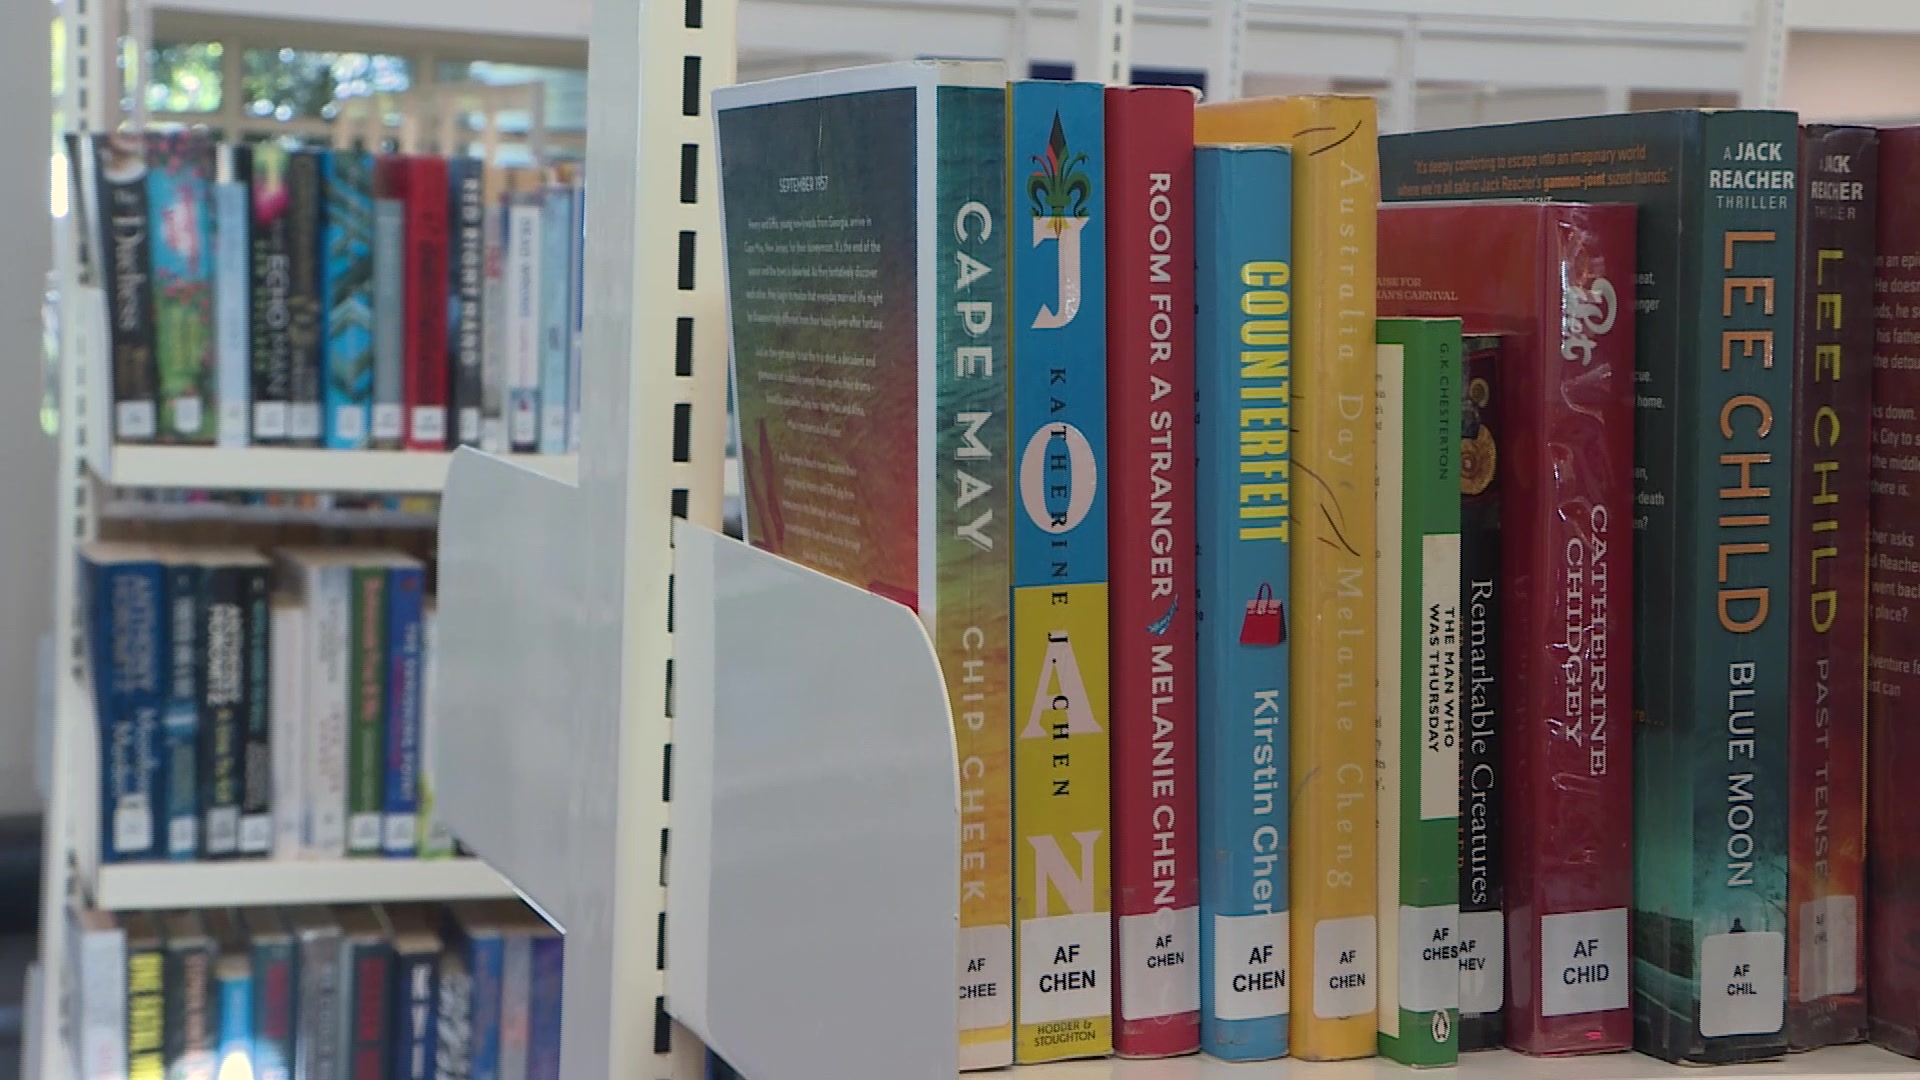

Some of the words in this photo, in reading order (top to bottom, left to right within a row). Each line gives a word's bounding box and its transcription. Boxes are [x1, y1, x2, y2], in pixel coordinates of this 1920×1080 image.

[1455, 155, 1496, 173] comforting
[1507, 154, 1537, 170] escape
[1570, 149, 1616, 168] imaginary
[1618, 144, 1646, 161] world
[1723, 146, 1732, 161] A
[1735, 141, 1783, 162] JACK
[1482, 177, 1500, 193] Jack
[1502, 174, 1541, 192] Reacher's
[1607, 170, 1632, 185] sized
[1709, 169, 1795, 189] REACHER
[1717, 195, 1788, 210] THRILLER
[1811, 180, 1864, 201] REACHER
[1149, 172, 1171, 284] ROOM
[1338, 159, 1365, 361] Australia
[954, 201, 992, 379] CAPE
[1405, 290, 1458, 301] CARNIVAL
[1720, 230, 1776, 371] LEE
[1149, 293, 1172, 365] FOR
[1814, 248, 1845, 383] LEE
[1893, 327, 1920, 345] fathe
[1149, 374, 1172, 402] A
[1240, 260, 1291, 543] COUNTERFEIT
[1327, 393, 1364, 466] Day
[954, 411, 993, 552] MAY
[1049, 367, 1068, 606] KATHERINE
[1150, 410, 1173, 601] STRANGER
[1717, 394, 1773, 634] CHILD
[1810, 404, 1841, 635] CHILD
[1336, 567, 1365, 732] Melanie
[1428, 603, 1440, 648] WAS
[1444, 605, 1456, 646] THE
[1565, 537, 1584, 748] CHIDGEY
[1590, 503, 1608, 777] CATHERINE
[962, 625, 984, 732] CHIP
[1444, 650, 1456, 695] MAN
[1471, 578, 1495, 755] Remarkable
[1151, 644, 1174, 799] MELANIE
[1428, 651, 1440, 753] THURSDAY
[1443, 699, 1455, 749] WHO
[1727, 660, 1756, 762] BLUE
[1815, 658, 1831, 750] PAST
[1051, 694, 1070, 797] CHEN
[1253, 689, 1280, 816] Kirstin
[962, 755, 985, 902] CHEEK
[1326, 763, 1364, 889] Cheng
[1470, 763, 1495, 906] Creatures
[1726, 772, 1755, 888] MOON
[1814, 762, 1830, 880] TENSE
[1152, 805, 1176, 905] CHEN
[1053, 944, 1081, 965] AF
[1155, 934, 1173, 949] AF
[1248, 945, 1273, 965] AF
[1340, 949, 1356, 965] AF
[1422, 945, 1458, 961] CHES
[1432, 927, 1450, 942] AF
[1573, 938, 1599, 959] AF
[967, 957, 986, 973] AF
[1039, 969, 1096, 993] CHEN
[1147, 952, 1185, 968] CHEN
[1232, 969, 1286, 993] CHEN
[1329, 973, 1366, 989] CHEN
[1458, 957, 1486, 971] HEV
[1562, 963, 1610, 985] CHID
[1733, 964, 1750, 978] AF
[1727, 983, 1758, 997] CHIL
[1034, 1030, 1096, 1047] STOUGHTON
[1037, 1020, 1080, 1035] HODDER
